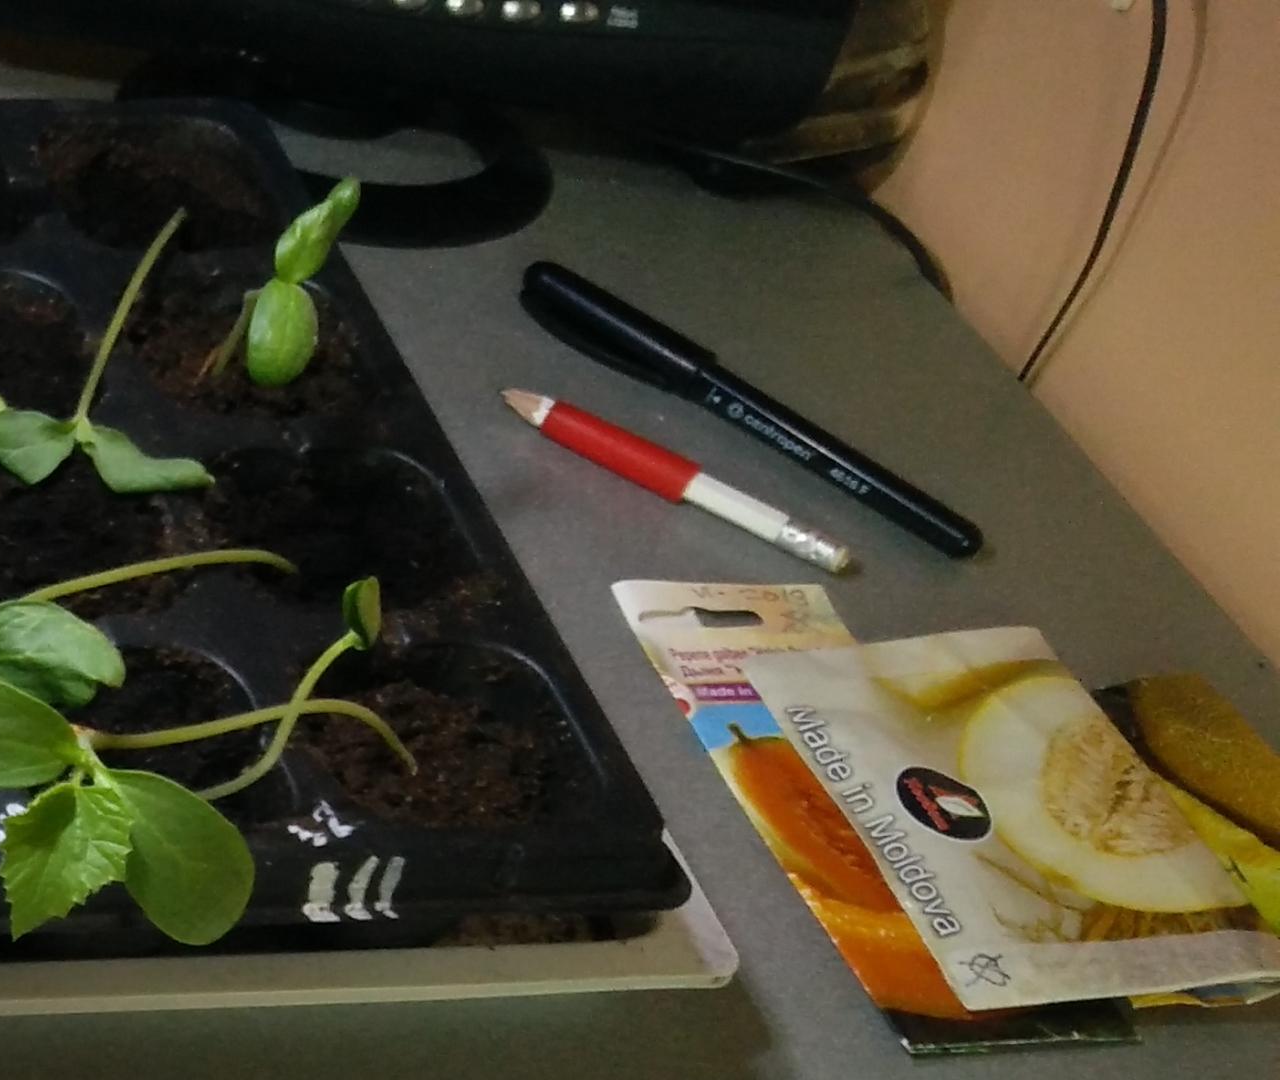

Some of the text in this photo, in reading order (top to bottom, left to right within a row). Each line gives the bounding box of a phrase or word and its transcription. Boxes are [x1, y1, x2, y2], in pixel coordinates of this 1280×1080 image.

[786, 703, 853, 783] Made
[841, 778, 875, 815] in
[865, 811, 963, 940] Moldova
